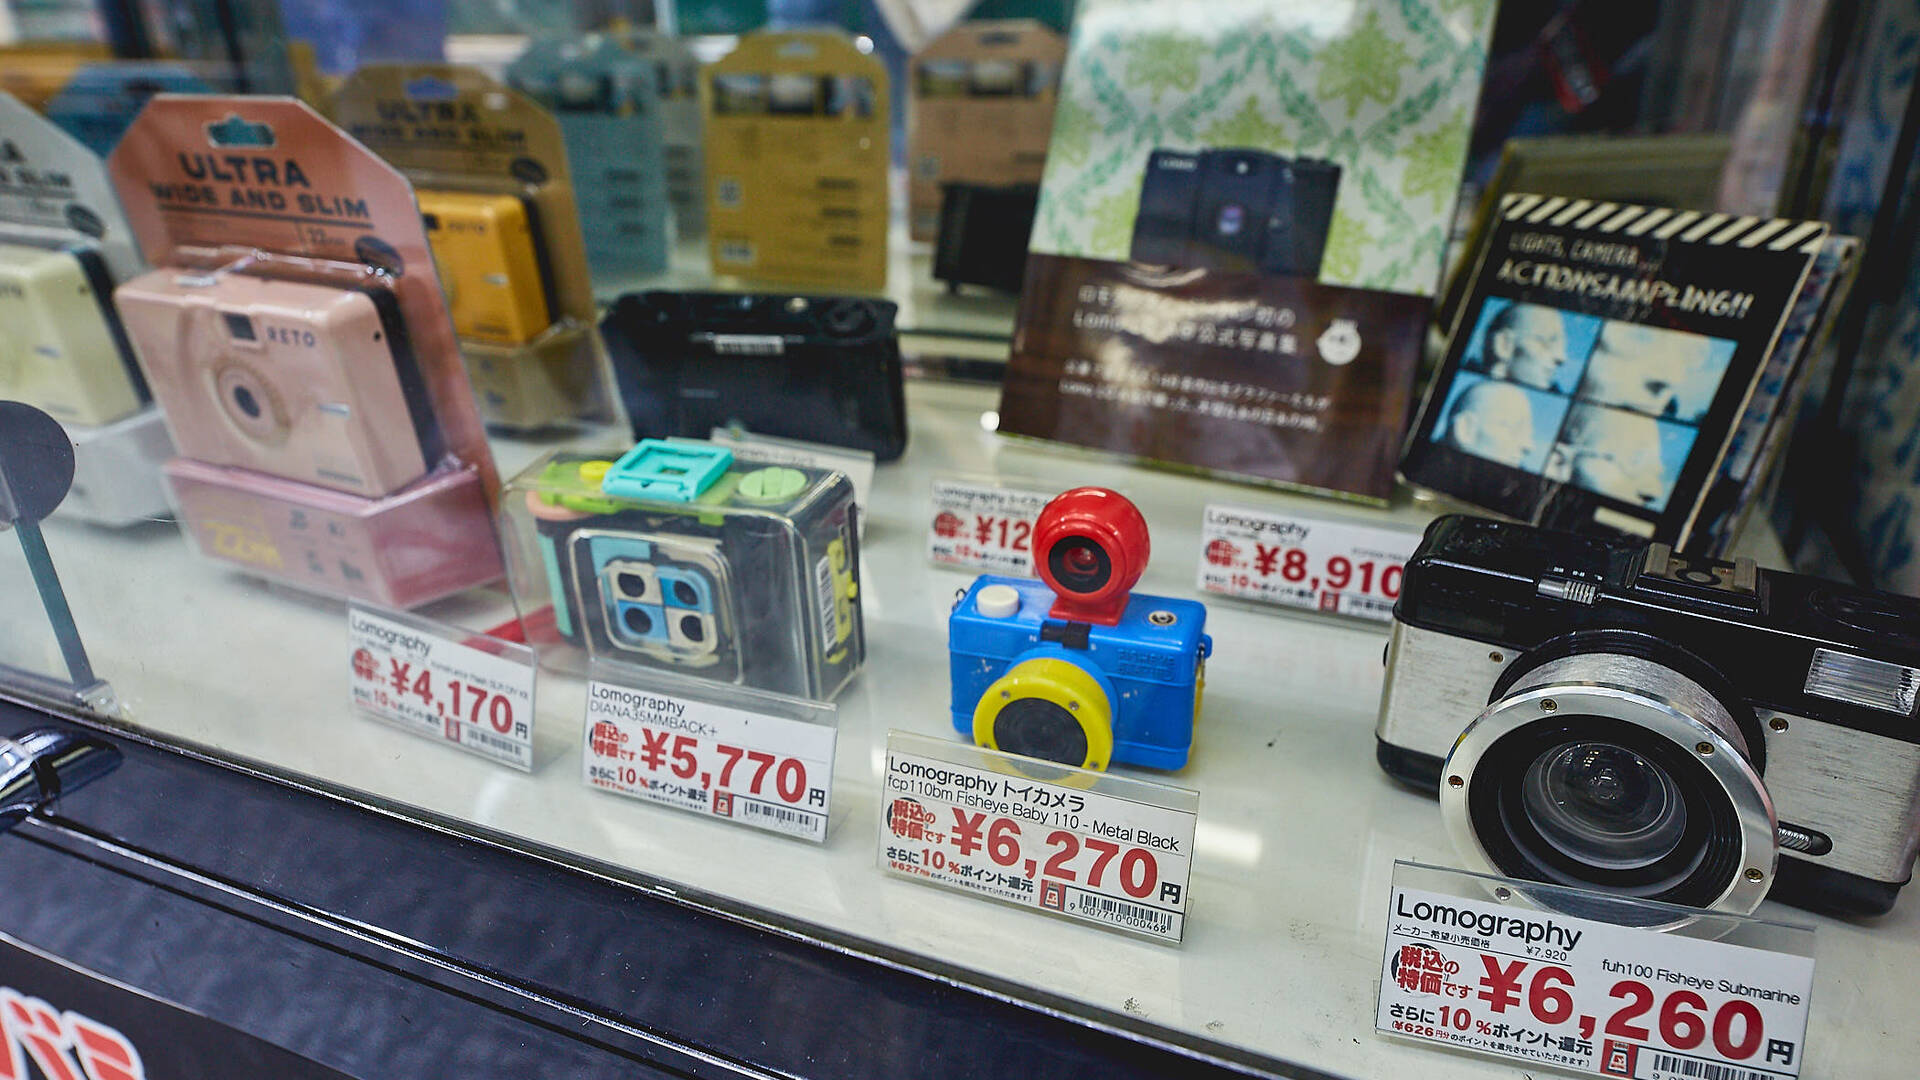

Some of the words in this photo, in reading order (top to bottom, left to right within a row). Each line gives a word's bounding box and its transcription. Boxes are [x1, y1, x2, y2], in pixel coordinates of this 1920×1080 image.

[178, 153, 310, 188] ULTRA
[151, 184, 218, 205] WIDE
[230, 189, 286, 210] AND
[296, 194, 371, 219] SLIM
[1496, 258, 1755, 320] ACTIONSAMPLING!!
[267, 327, 314, 347] RETO
[1208, 510, 1310, 539] Lomography
[1254, 543, 1403, 599] ¥8,910
[351, 614, 432, 657] Lomography
[390, 657, 513, 734] ¥4,170
[515, 722, 528, 740] 円
[591, 684, 685, 717] Lomography
[590, 701, 719, 737] DIANA35MMBACK+
[641, 728, 807, 803] ¥5,770
[808, 787, 826, 808] 円
[890, 756, 998, 796] Lomography
[1003, 781, 1085, 813] トイカメラ
[887, 774, 953, 803] fcp110bm
[957, 790, 1009, 815] Fisheye
[1012, 802, 1049, 826] Baby
[1054, 811, 1079, 829] 110
[1092, 819, 1134, 842] Metal
[1136, 830, 1180, 852] Black
[891, 798, 936, 825] 税込の
[891, 817, 946, 844] 特価です
[950, 806, 1158, 899] ¥6,270
[1159, 881, 1181, 905] 円
[1397, 893, 1582, 951] Lomography
[1394, 924, 1490, 948] メーカー希望小売価格
[1526, 946, 1567, 962] ¥7,920
[1400, 945, 1460, 975] 税込の
[1397, 968, 1473, 998] 特価です
[1602, 959, 1652, 979] fuh100
[1657, 969, 1714, 990] Fisheye
[1717, 980, 1801, 1005] Submarine
[1478, 954, 1764, 1060] ¥6,260
[1765, 1038, 1795, 1065] 円
